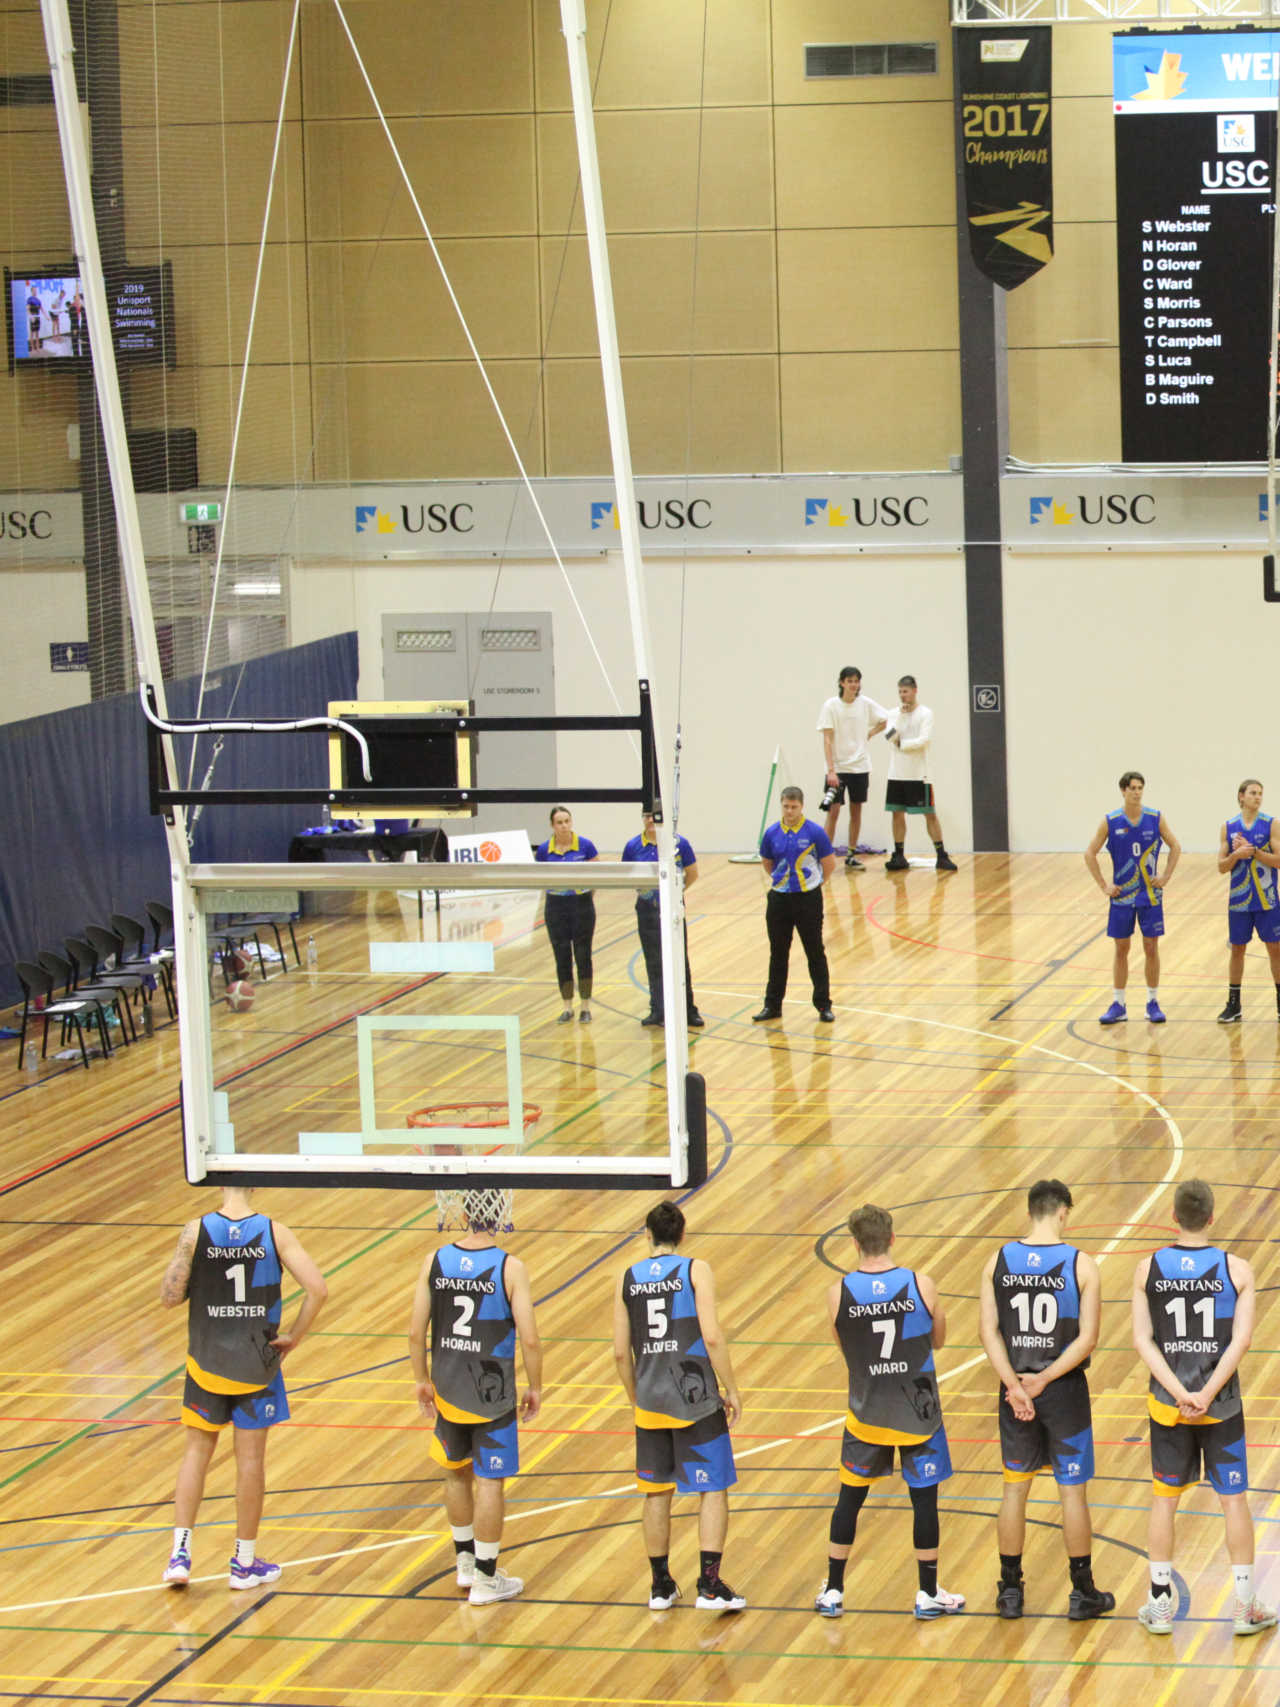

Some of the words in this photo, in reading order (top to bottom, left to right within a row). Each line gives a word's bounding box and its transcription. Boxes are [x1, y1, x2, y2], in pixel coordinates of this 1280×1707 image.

[963, 104, 1049, 137] 2017
[1223, 137, 1250, 148] USC
[966, 142, 1048, 169] Champions
[1202, 160, 1269, 187] USC
[1181, 205, 1211, 214] NAME
[1142, 221, 1152, 232] S
[1155, 221, 1211, 232] Webster
[1142, 241, 1153, 252] N
[1157, 240, 1197, 251] Horan
[1143, 260, 1153, 271] D
[1157, 259, 1202, 270] Glover
[124, 285, 144, 293] 2019
[1144, 279, 1153, 290] C
[1157, 278, 1192, 289] Ward
[118, 296, 151, 306] Unisport
[1144, 298, 1153, 309] S
[1158, 297, 1201, 308] Morris
[115, 319, 156, 328] Swimming
[1144, 317, 1154, 328] C
[1158, 317, 1213, 327] Parsons
[1145, 336, 1154, 347] T
[1158, 335, 1221, 349] Campbell
[1145, 355, 1154, 366] S
[1159, 355, 1191, 366] Luca
[1146, 375, 1155, 385] B
[1159, 374, 1213, 388] Maguire
[1146, 394, 1156, 404] D
[1160, 393, 1199, 404] Smith
[638, 499, 713, 530] USC
[852, 496, 930, 526] USC
[1077, 494, 1156, 524] USC
[402, 503, 475, 533] USC
[1133, 842, 1141, 856] 0
[207, 1246, 265, 1259] SPARTANS
[225, 1264, 246, 1302] 1
[435, 1277, 494, 1294] SPARTANS
[630, 1279, 682, 1296] SPARTANS
[1003, 1274, 1065, 1289] SPARTANS
[1155, 1279, 1222, 1293] SPARTANS
[208, 1305, 265, 1317] WEBSTER
[849, 1299, 915, 1318] SPARTANS
[1010, 1293, 1057, 1334] 10
[452, 1295, 475, 1337] 2
[647, 1298, 667, 1338] 5
[1164, 1297, 1215, 1337] 11
[441, 1337, 481, 1353] HORAN
[872, 1319, 896, 1360] 7
[1012, 1336, 1054, 1348] MORRIS
[1164, 1340, 1219, 1354] PARSONS
[869, 1362, 908, 1376] WARD
